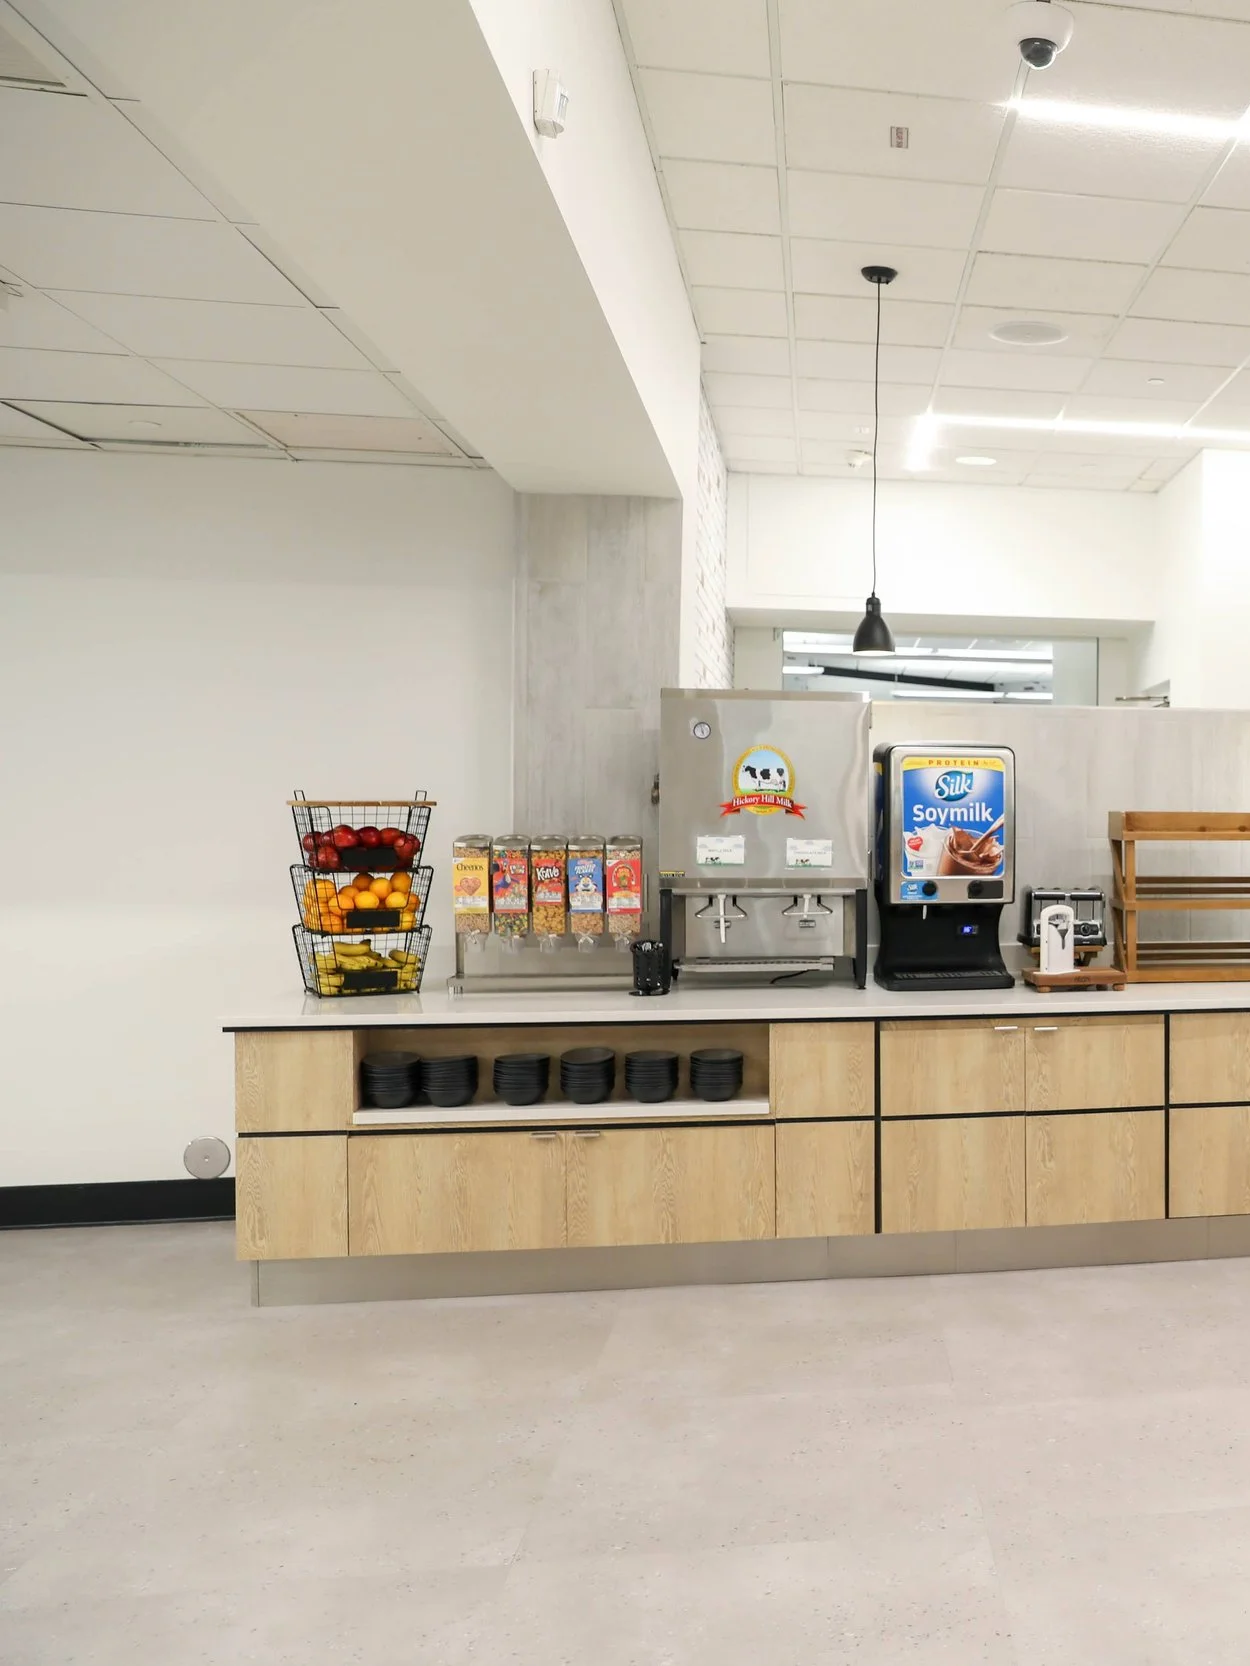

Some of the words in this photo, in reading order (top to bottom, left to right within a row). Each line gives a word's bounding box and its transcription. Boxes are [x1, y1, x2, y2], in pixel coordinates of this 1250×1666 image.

[934, 773, 974, 799] Silk
[733, 795, 760, 807] Hickory
[761, 794, 775, 804] Hill
[776, 796, 792, 808] Milk
[912, 801, 994, 825] Soymilk
